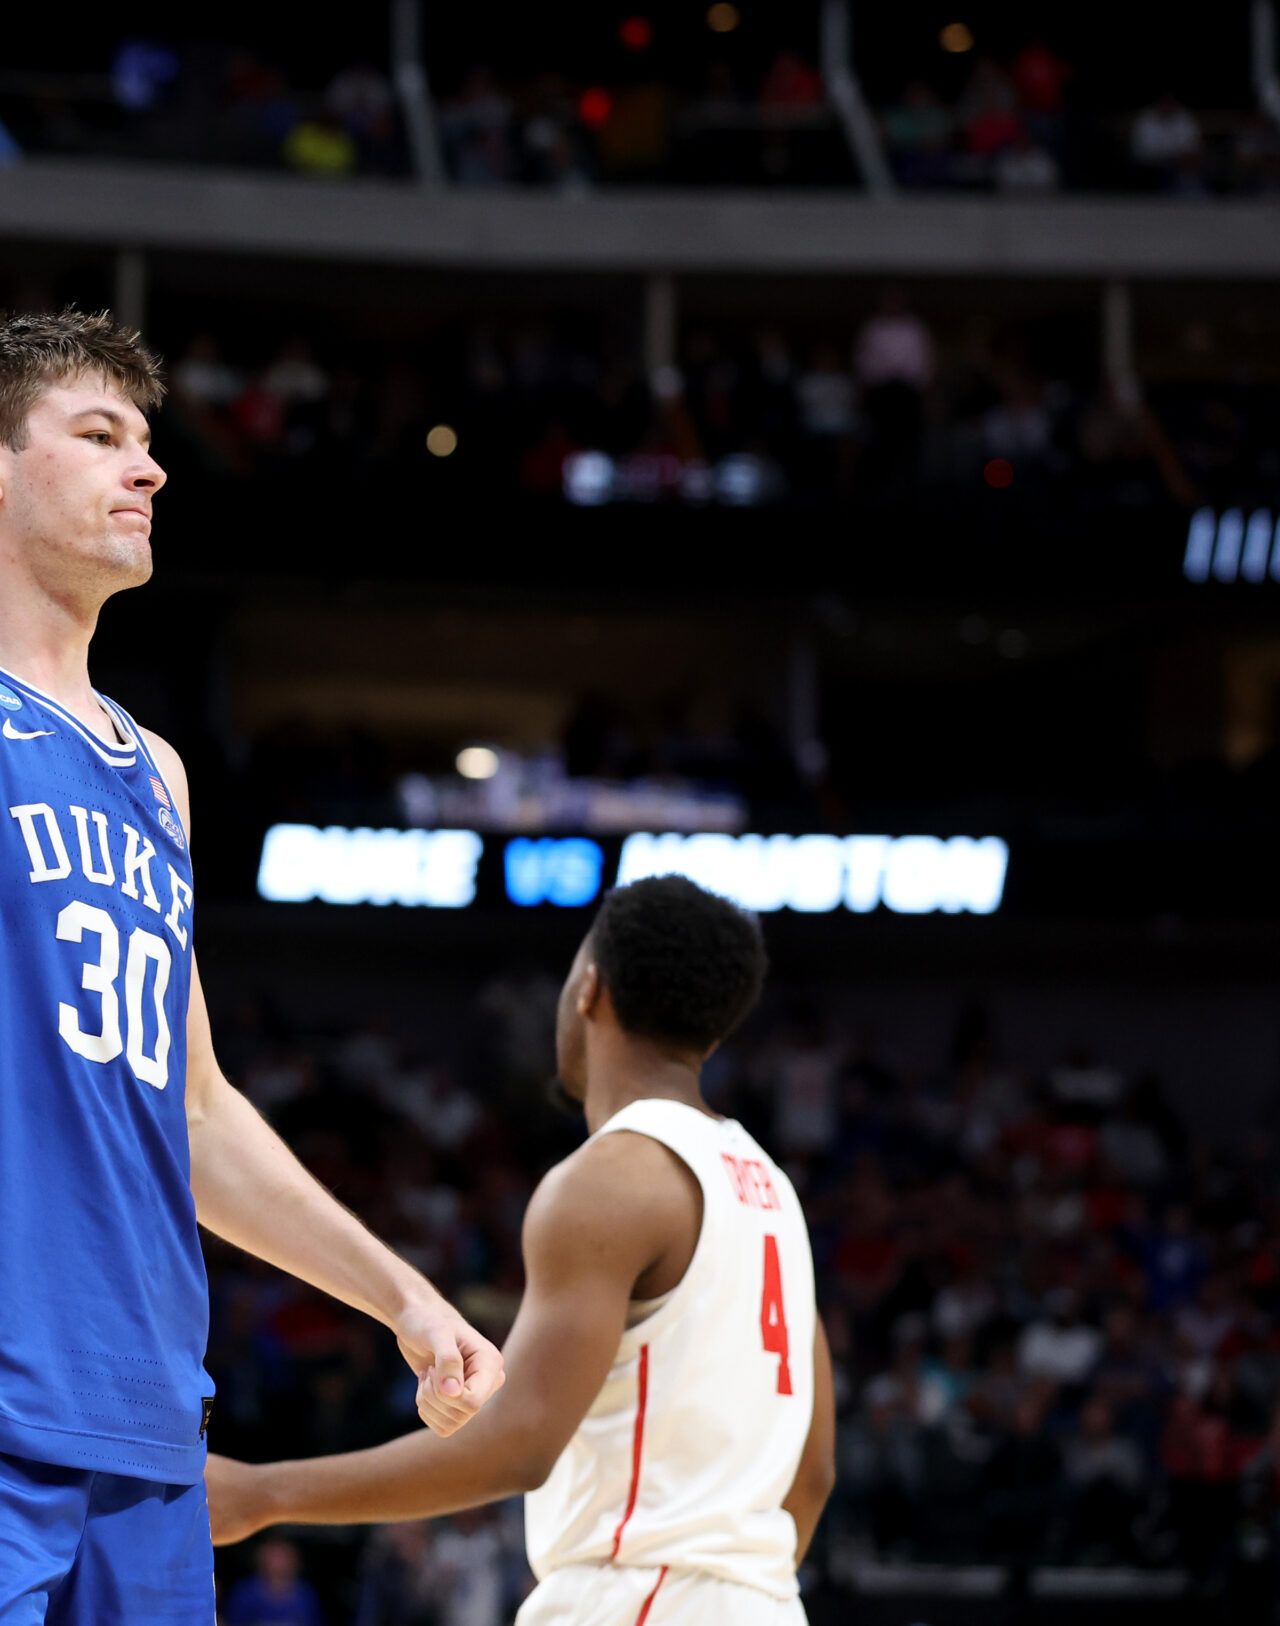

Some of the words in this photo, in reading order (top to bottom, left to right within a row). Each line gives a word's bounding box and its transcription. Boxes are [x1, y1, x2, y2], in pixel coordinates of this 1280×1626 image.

[9, 801, 193, 952] DUKE
[55, 899, 172, 1091] 30
[760, 1233, 794, 1396] 4
